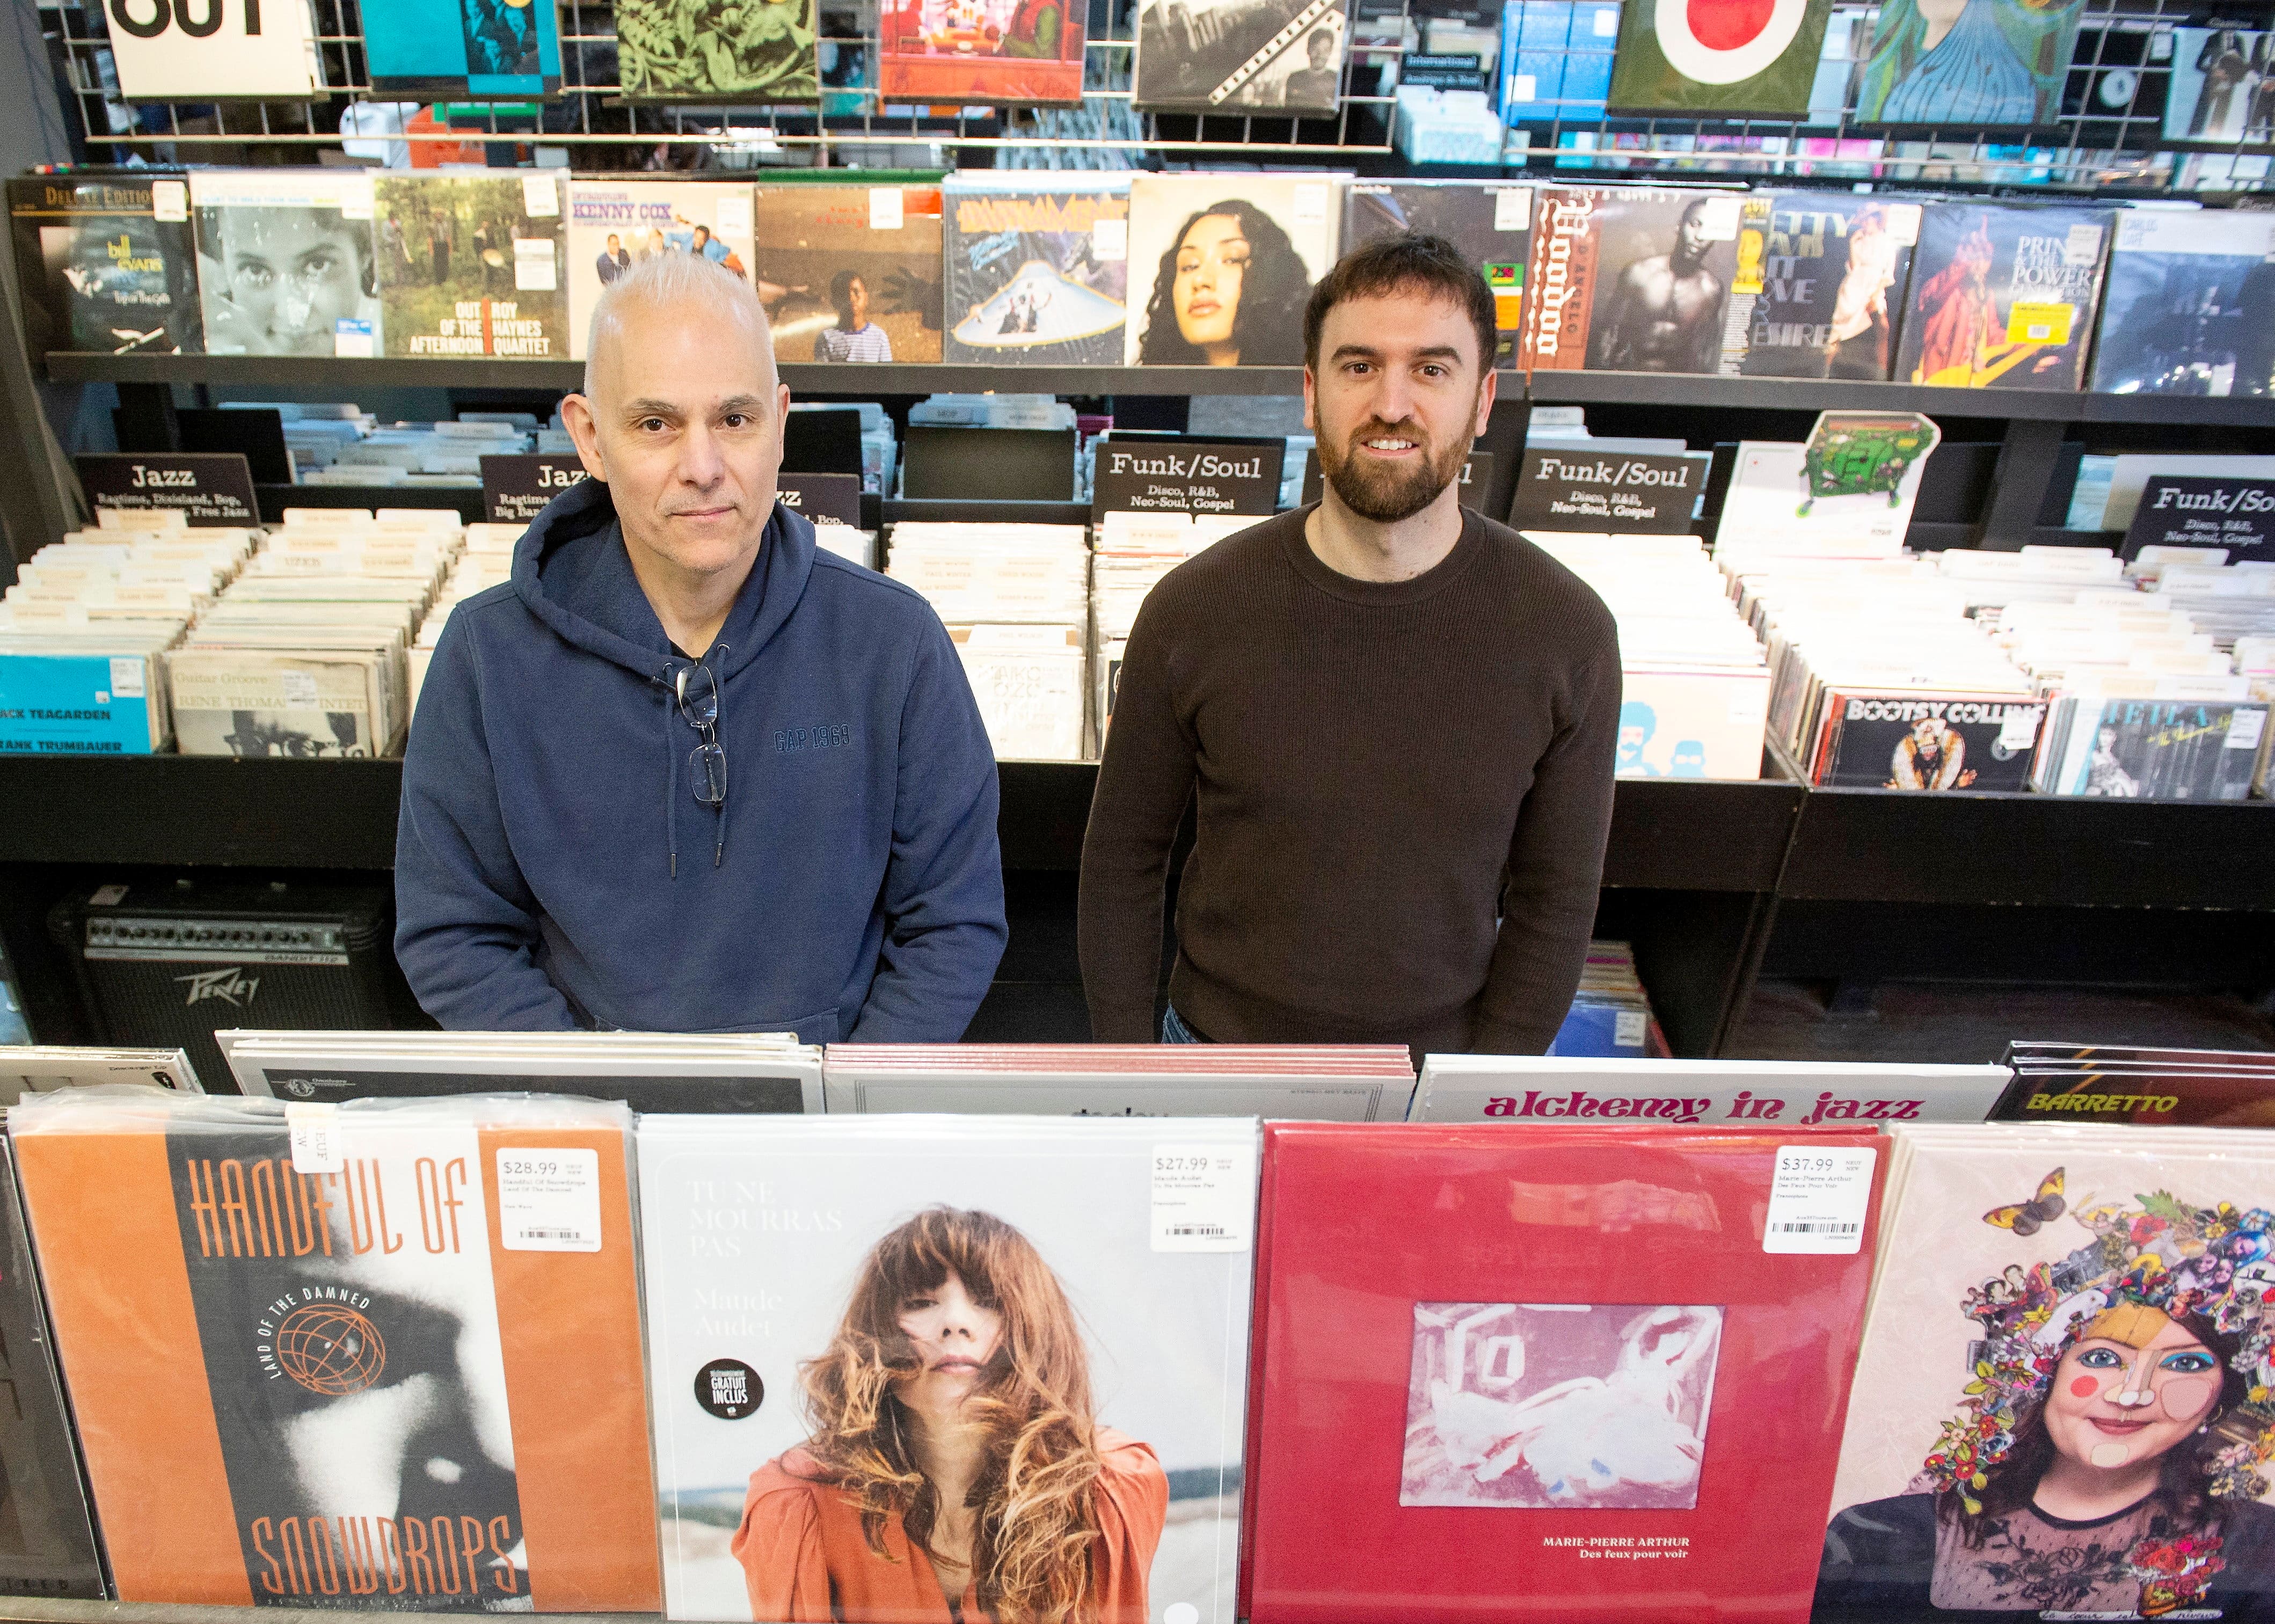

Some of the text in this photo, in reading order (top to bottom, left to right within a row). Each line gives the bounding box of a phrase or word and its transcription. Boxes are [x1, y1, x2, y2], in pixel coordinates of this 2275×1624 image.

[103, 186, 153, 204] EDITIO
[573, 201, 672, 220] KENNY COX
[107, 235, 130, 258] bill
[2017, 235, 2070, 255] PRIN
[2011, 268, 2091, 287] POWER
[455, 301, 482, 318] OUT
[491, 302, 518, 319] ROY
[440, 318, 483, 336] OF THE
[491, 319, 543, 337] HAYNES
[410, 335, 484, 354] AFTERNOON
[493, 336, 551, 357] QUARTET
[1109, 452, 1262, 479] Funk/Soul
[1535, 458, 1689, 488] Funk/Soul
[132, 465, 197, 488] Jazz
[537, 465, 592, 488] Jaz
[1147, 484, 1220, 499] Disco, R&B,
[1570, 491, 1607, 504] Disco,
[2152, 487, 2275, 514] Funk/So
[193, 506, 250, 518] Free Jazz
[1129, 495, 1235, 511] Neo-Soul, Gospel
[1550, 501, 1656, 520] Neo-Soul, Gospel
[495, 506, 543, 520] Big Ban
[174, 672, 268, 685] Guitar Groove
[228, 696, 286, 709] THOMA
[319, 697, 366, 709] INTET
[1846, 699, 1948, 722] BOOTSY
[0, 708, 111, 721] ACK TEAGARDEN
[0, 740, 122, 752] RANK TRUMBAUER
[774, 723, 851, 752] GAP 1969
[1484, 1091, 1926, 1125] alchemy in jazz
[2026, 1093, 2179, 1113] BARRETTO
[316, 1126, 328, 1161] EUF
[504, 1161, 557, 1175] $28.99
[1156, 1158, 1208, 1171] $27.99
[1782, 1158, 1833, 1172] $37.99
[687, 1180, 777, 1203] TU NE
[188, 1157, 468, 1257] HANDFUL OF
[689, 1208, 842, 1231] MOURRAS
[691, 1235, 741, 1257] PAS
[695, 1288, 782, 1311] Maude
[257, 1286, 370, 1380] LAND OF THE DAMNED
[695, 1314, 770, 1336] Audet
[711, 1376, 746, 1390] GRATUIT
[712, 1388, 748, 1404] INCLUS
[1543, 1537, 1690, 1547] MARIE-PIERRE ARTHUR
[251, 1515, 518, 1595] SNOWDROPS
[1579, 1549, 1688, 1560] Des feux pour voir
